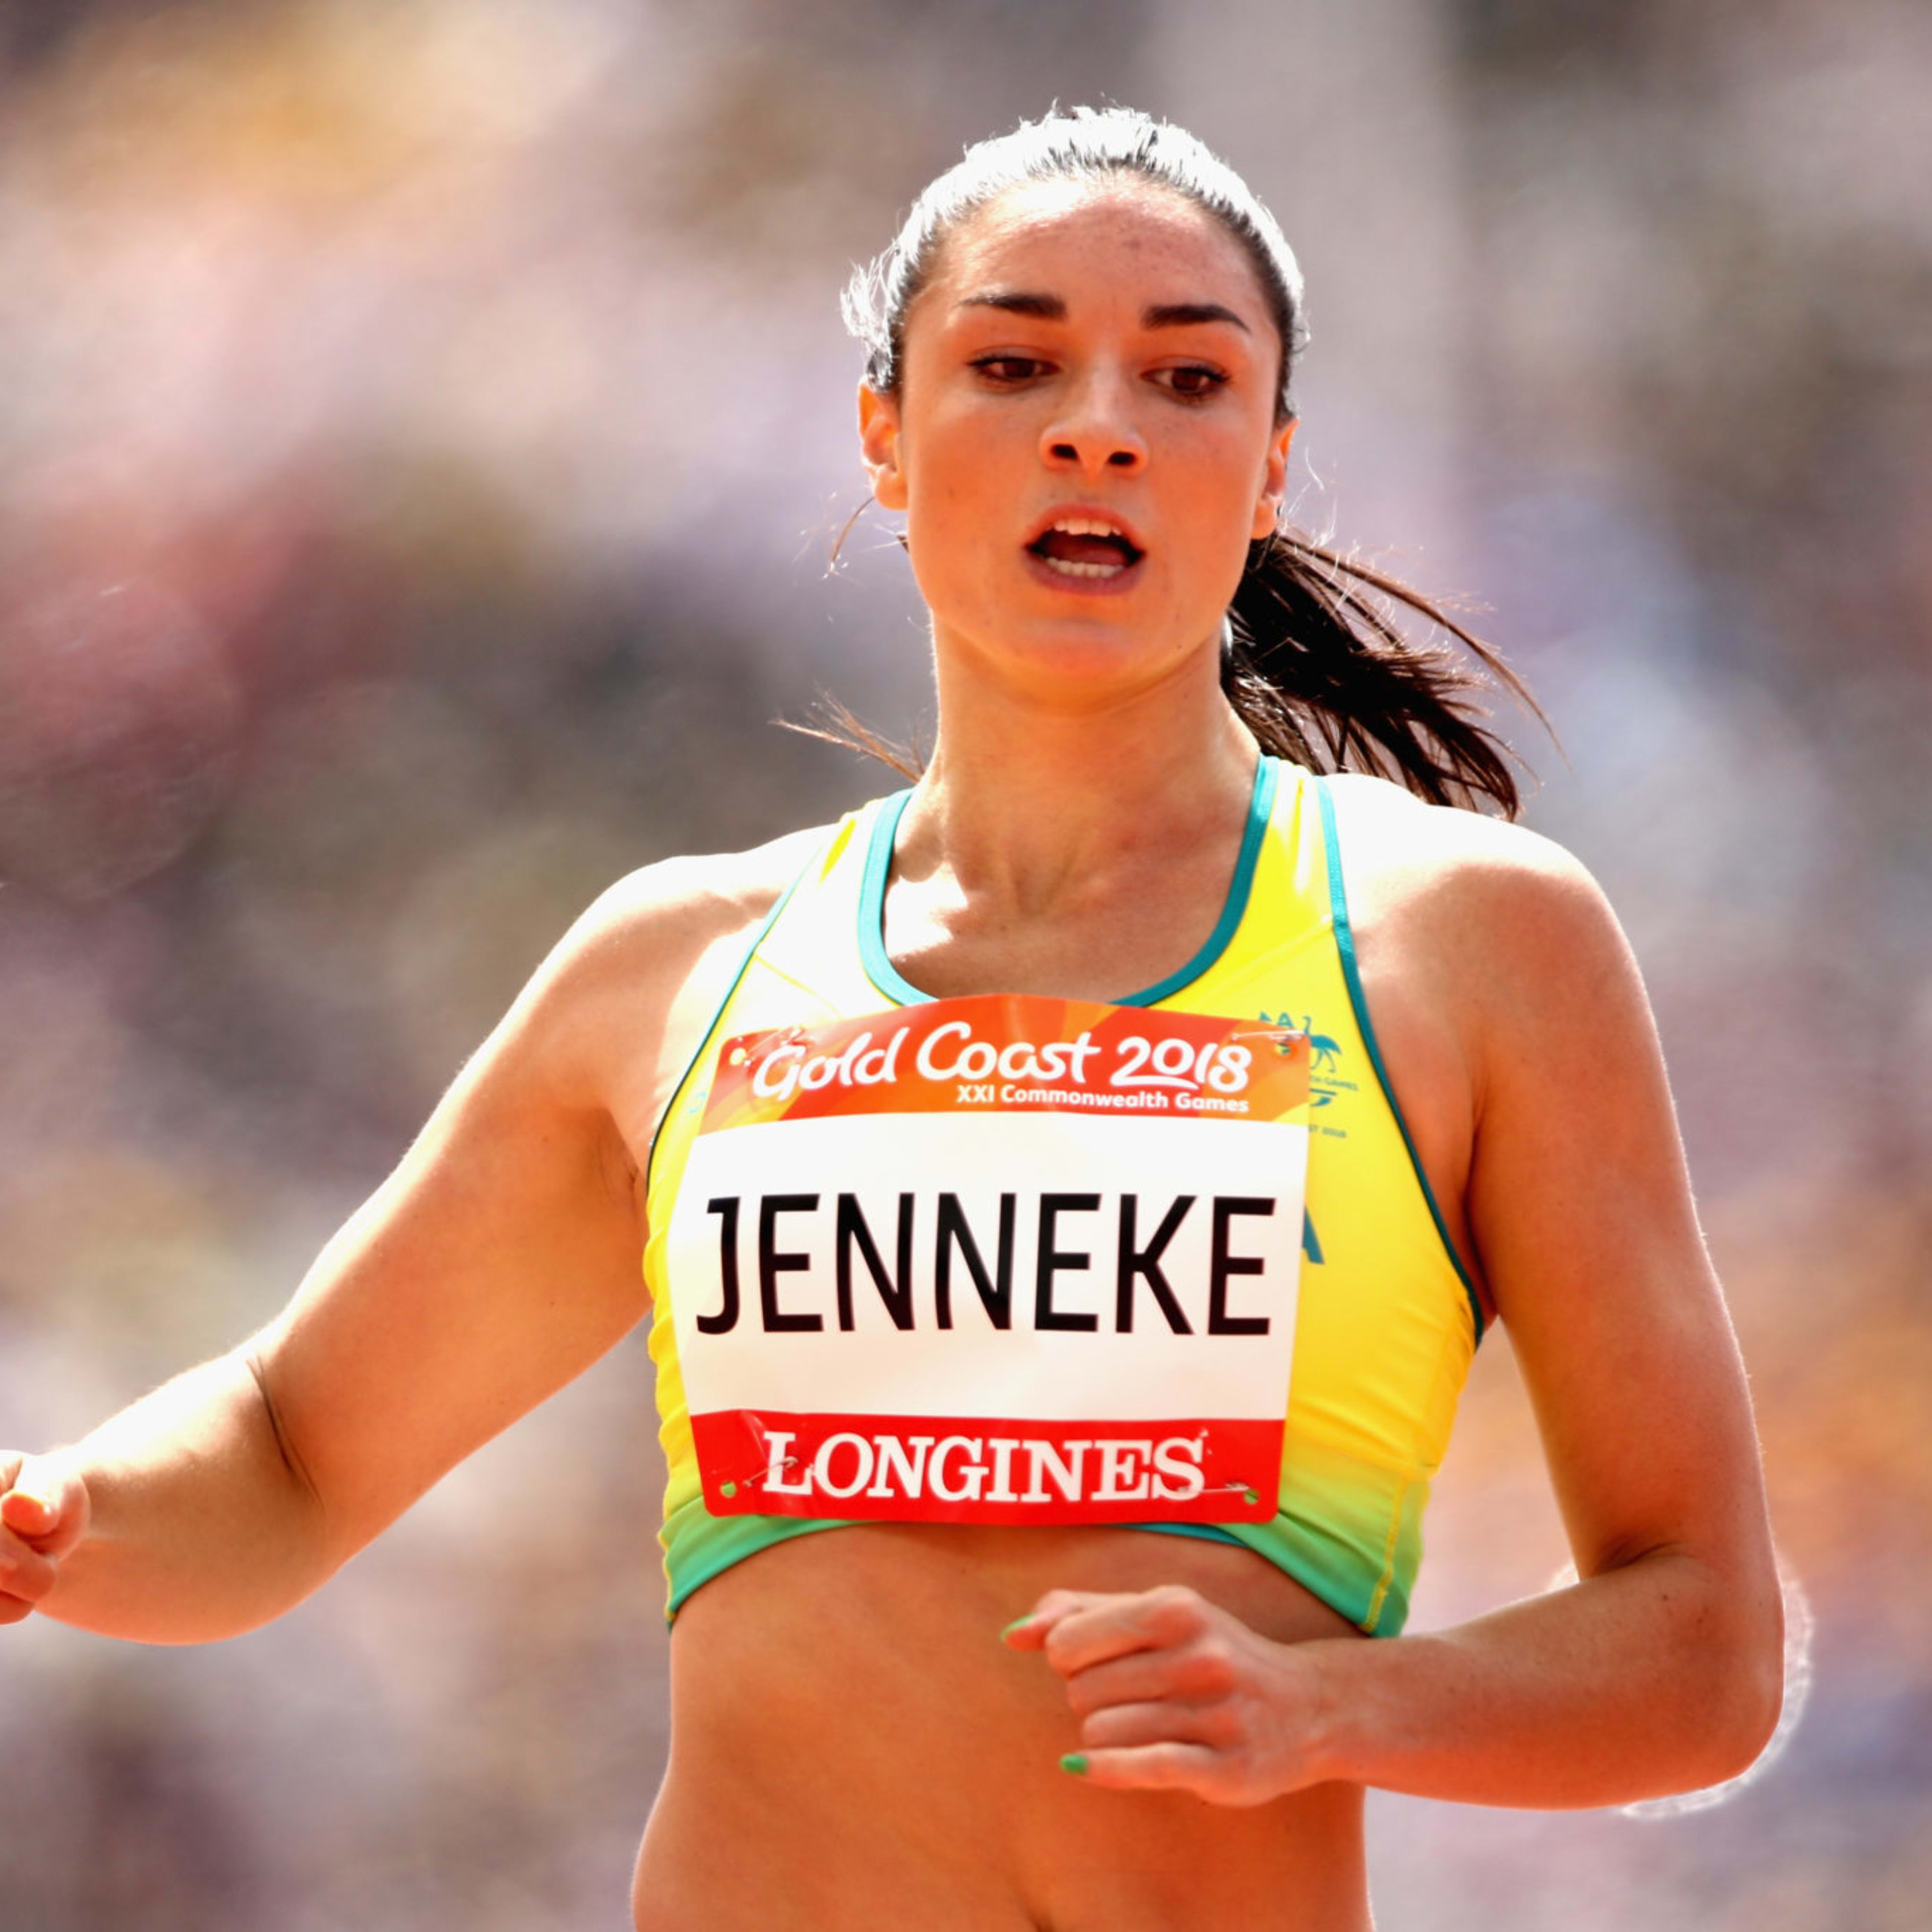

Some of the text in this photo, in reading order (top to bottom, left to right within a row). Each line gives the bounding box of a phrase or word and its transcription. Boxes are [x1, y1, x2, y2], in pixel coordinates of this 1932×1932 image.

[753, 1021, 1252, 1101] Gold Coast 2018
[957, 1085, 1249, 1112] XXI Commonwealth Games
[696, 1192, 1276, 1335] JENNEKE
[763, 1430, 1205, 1503] LONGINES
